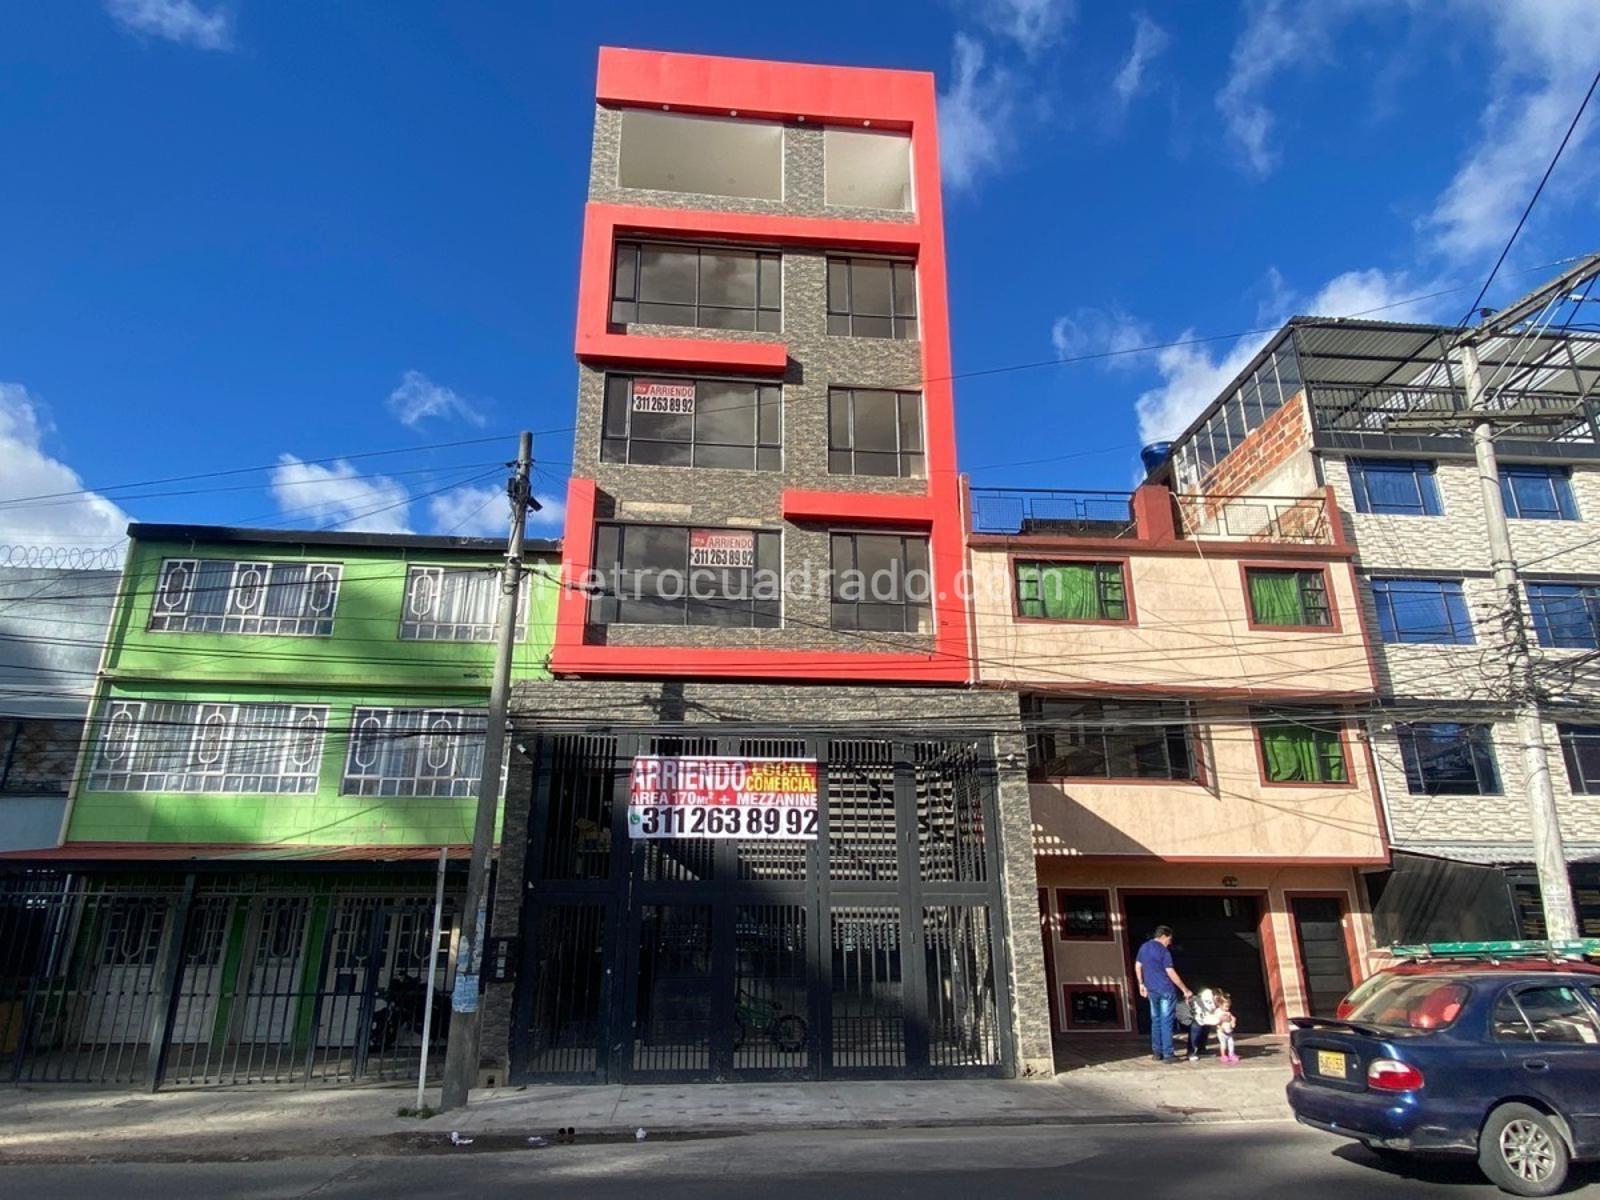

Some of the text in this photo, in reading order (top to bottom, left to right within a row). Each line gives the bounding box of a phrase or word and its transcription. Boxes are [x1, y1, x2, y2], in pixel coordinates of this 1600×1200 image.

[650, 385, 693, 397] ARRIENDO
[709, 537, 752, 549] ARRIENDO
[631, 760, 745, 790] ARRIENDO
[752, 763, 811, 776] LOCAL
[746, 776, 817, 792] COMERCIAL
[631, 792, 669, 805] AREA
[736, 793, 818, 806] MEZZANINE
